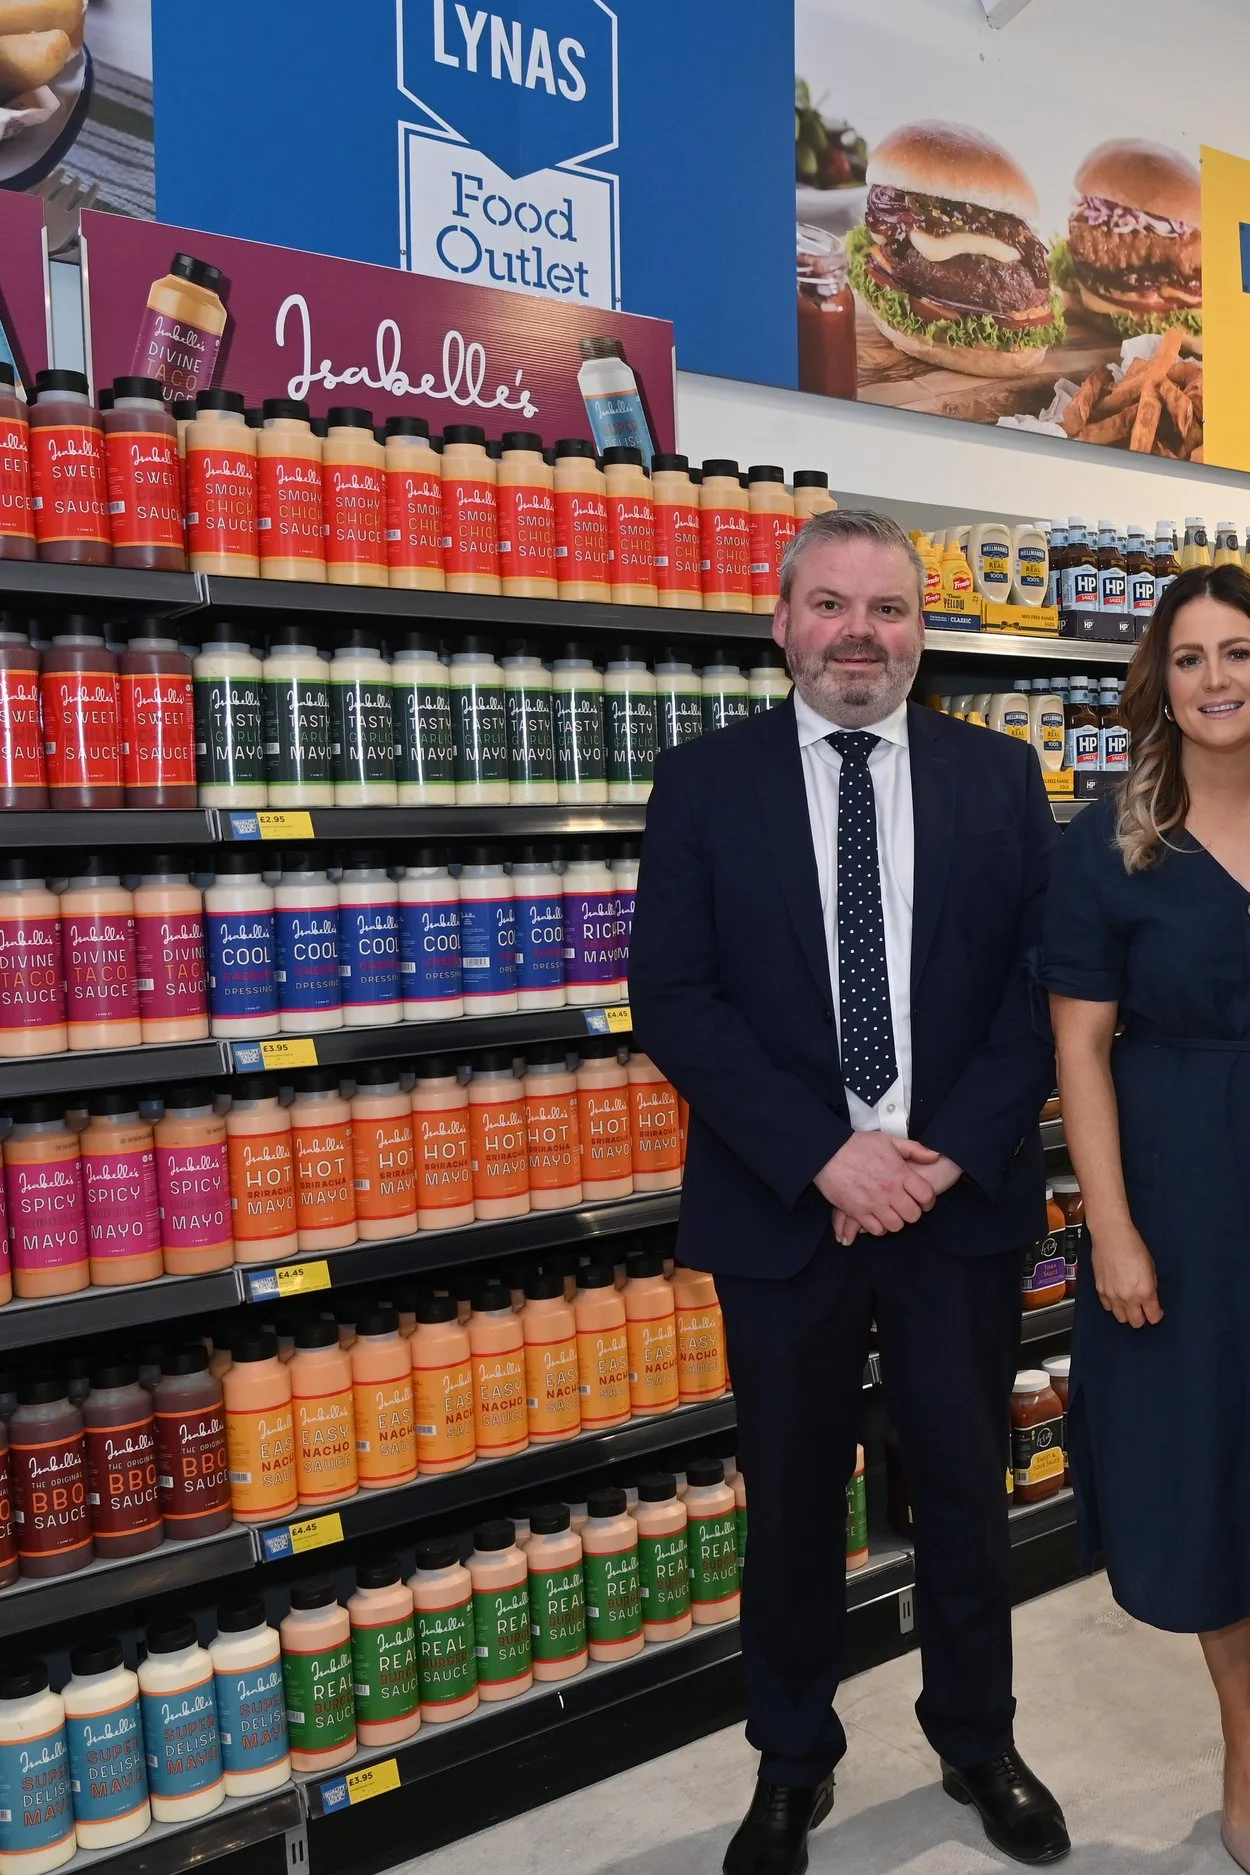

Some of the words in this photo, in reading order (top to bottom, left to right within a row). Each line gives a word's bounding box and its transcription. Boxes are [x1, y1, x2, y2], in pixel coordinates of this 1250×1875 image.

[435, 0, 587, 102] LYNAS
[452, 171, 577, 242] Food
[436, 225, 589, 298] Outlet
[154, 316, 205, 351] Isabelle's
[149, 341, 202, 373] DIVINE
[275, 294, 540, 419] Isabelle's
[146, 358, 197, 391] TACO
[163, 386, 194, 401] UCE
[52, 465, 101, 479] SWEET
[205, 483, 253, 497] SMOKY
[55, 500, 105, 515] SAUCE
[335, 496, 381, 509] SMOKY
[205, 516, 254, 533] SAUCE
[336, 528, 382, 543] SAUCE
[1078, 576, 1096, 592] HP
[1106, 579, 1124, 594] HP
[1136, 584, 1153, 598] HP
[943, 598, 964, 610] YELLOW
[64, 710, 115, 725] SWEET
[137, 711, 184, 726] SWEET
[214, 713, 262, 728] TASTY
[613, 722, 654, 734] TASTY
[614, 737, 654, 747] GARLIC
[1079, 737, 1097, 752] HP
[1108, 738, 1126, 752] HP
[66, 746, 118, 761] SAUCE
[139, 746, 189, 760] SAUCE
[217, 746, 263, 760] MAYO
[614, 750, 654, 763] MAYO
[260, 814, 285, 824] £2.95
[70, 925, 125, 944] Isabelle's
[72, 948, 127, 964] DIVINE
[222, 947, 272, 966] COOL
[74, 965, 128, 982] TACO
[75, 984, 128, 999] SAUCE
[224, 985, 273, 996] DRESSING
[607, 1010, 628, 1018] £4.45
[263, 1043, 288, 1053] £3.95
[528, 1125, 569, 1143] HOT
[528, 1143, 571, 1154] SRIRACHA
[300, 1158, 345, 1178] HOT
[529, 1153, 571, 1169] MAYO
[170, 1176, 222, 1194] SPICY
[300, 1178, 347, 1190] SRIRACHA
[88, 1186, 141, 1203] SPICY
[301, 1188, 348, 1205] MAYO
[172, 1211, 224, 1230] MAYO
[90, 1221, 143, 1239] MAYO
[278, 1268, 304, 1279] £4.45
[302, 1425, 349, 1445] EASY
[200, 1438, 225, 1451] ORIGINAL
[302, 1441, 350, 1458] NACHO
[183, 1447, 227, 1478] BBQ
[303, 1455, 351, 1473] SAUCE
[51, 1472, 83, 1486] ORIGINAL
[184, 1469, 228, 1493] SAUCE
[32, 1481, 85, 1514] BBQ
[35, 1509, 86, 1530] SAUCE
[292, 1522, 318, 1536] £4.45
[702, 1541, 736, 1559] REAL
[422, 1636, 466, 1657] REAL
[422, 1651, 468, 1669] BURGER
[423, 1663, 469, 1682] SAUCE
[164, 1714, 215, 1741] SUPER
[165, 1733, 217, 1757] DELISH
[167, 1747, 218, 1775] MAYO
[349, 1772, 374, 1788] £3.95
